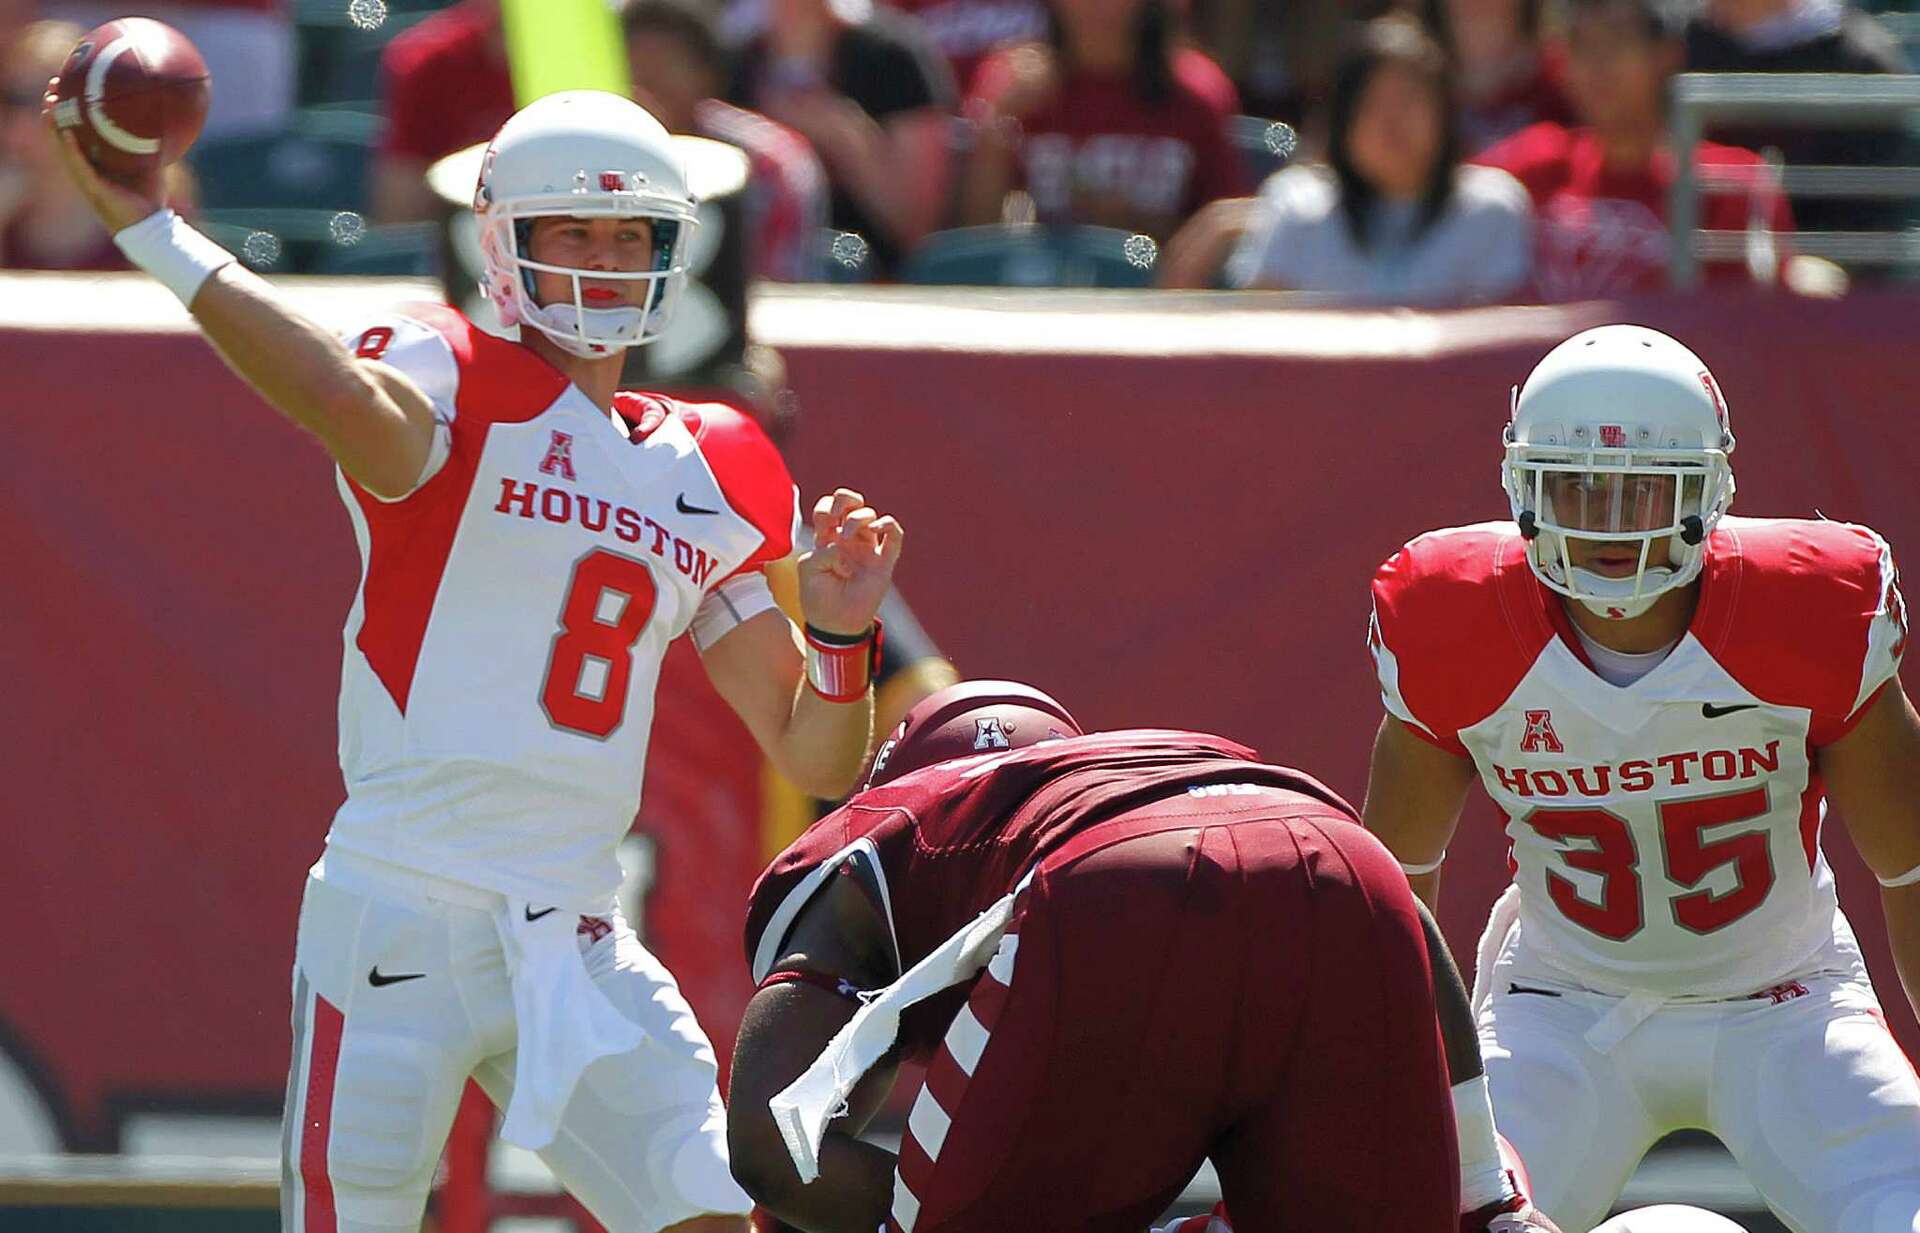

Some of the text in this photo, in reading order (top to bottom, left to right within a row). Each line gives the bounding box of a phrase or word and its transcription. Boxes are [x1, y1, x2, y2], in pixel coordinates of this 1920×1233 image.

[538, 429, 577, 482] A
[494, 476, 719, 589] HOUSTON
[537, 545, 659, 742] 8
[974, 717, 1010, 750] A
[1520, 710, 1564, 753] A
[1493, 740, 1780, 797] HOUSTON
[1521, 783, 1776, 942] 35
